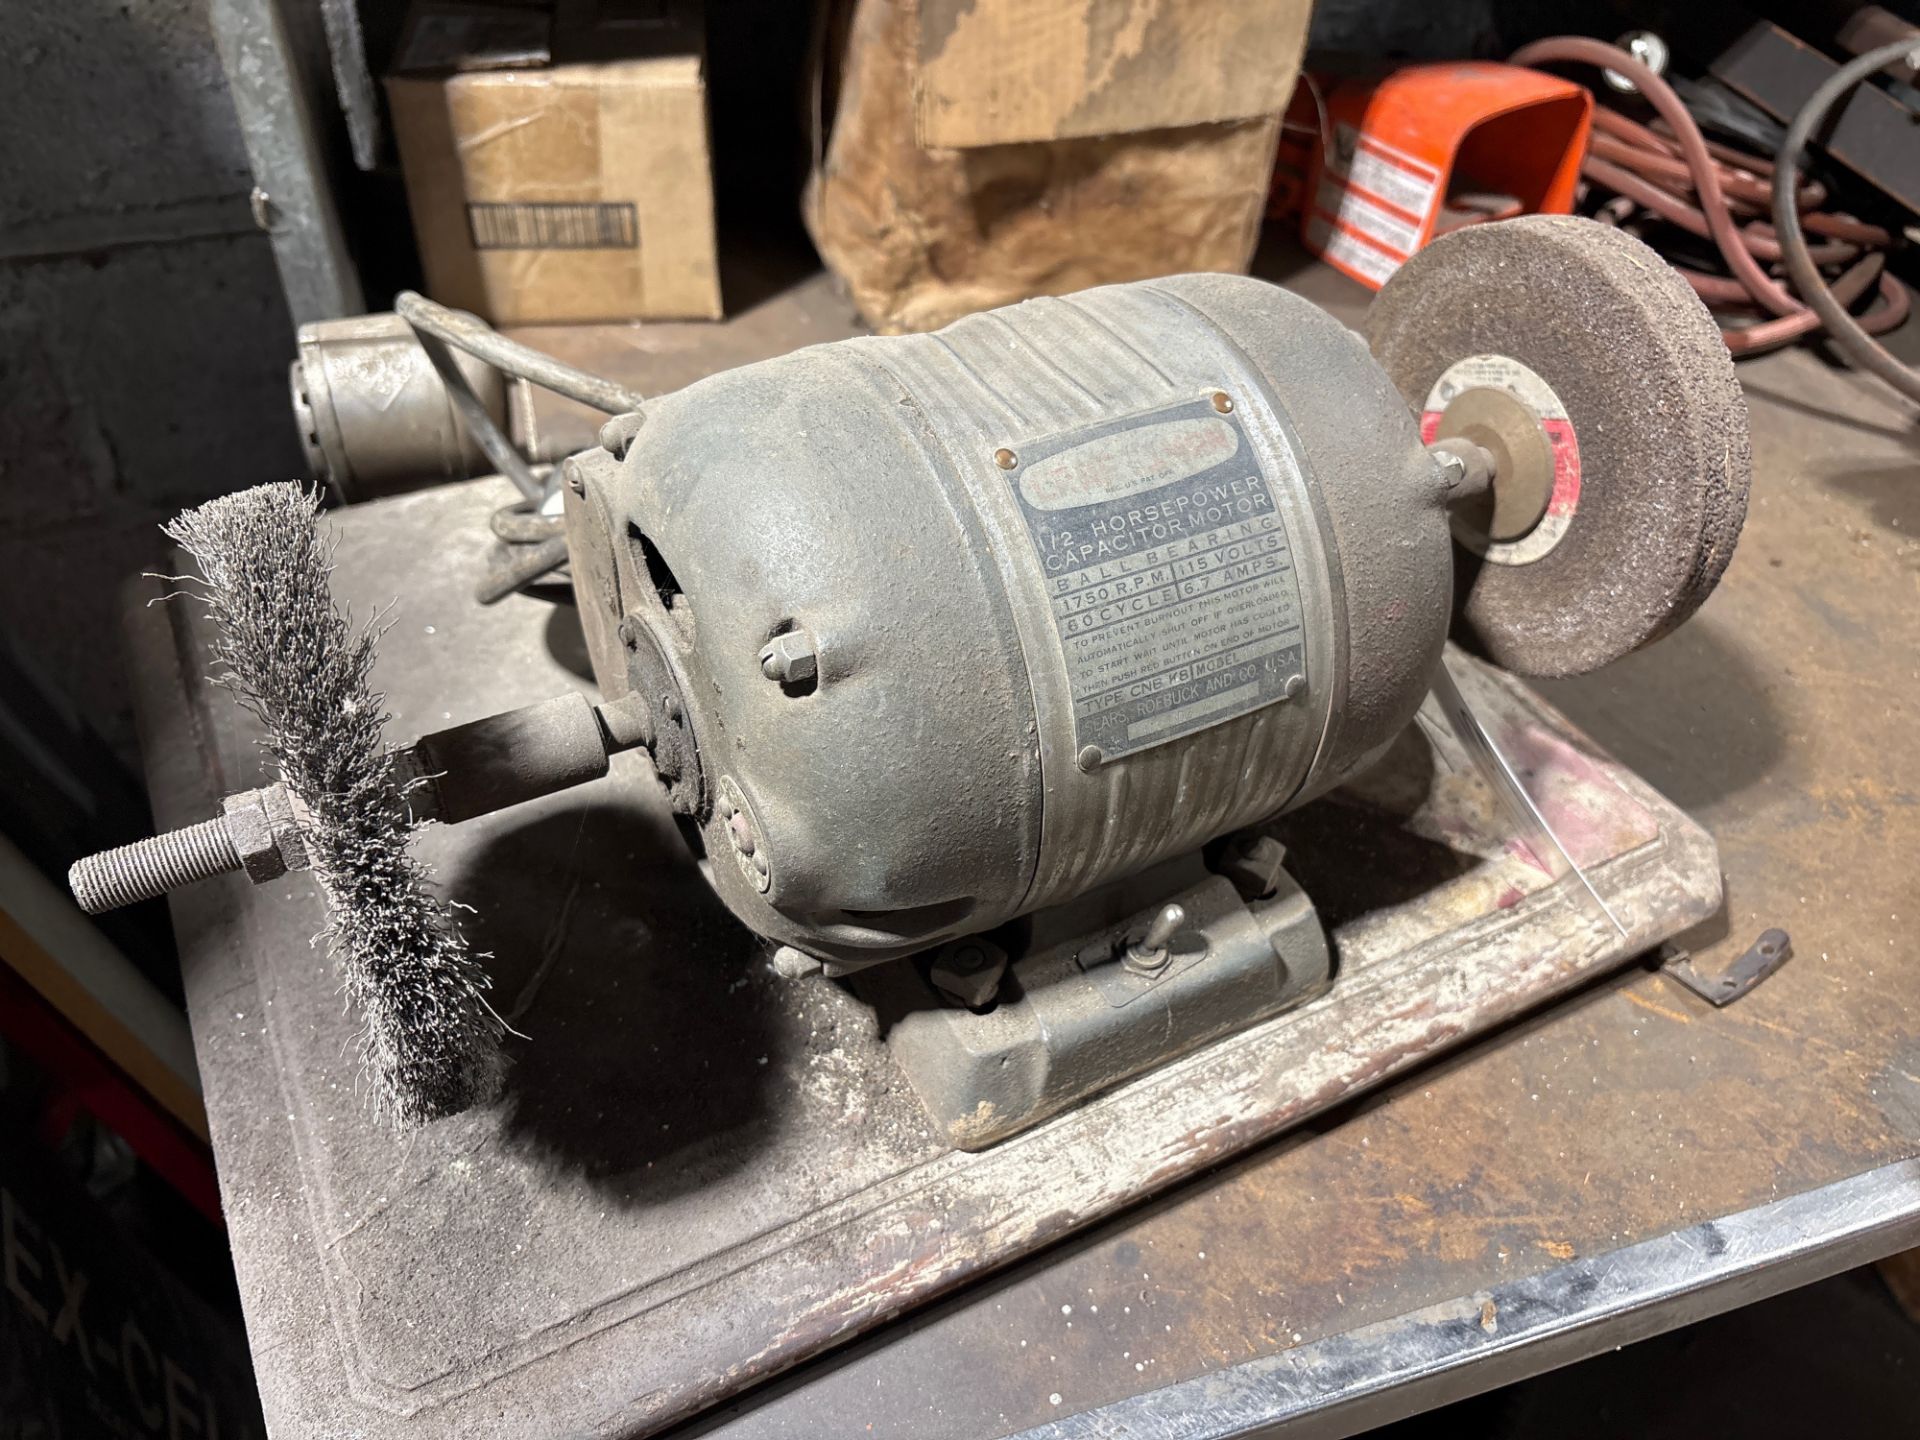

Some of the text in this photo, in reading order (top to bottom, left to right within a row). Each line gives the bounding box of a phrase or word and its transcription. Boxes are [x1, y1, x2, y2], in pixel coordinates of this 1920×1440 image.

[1038, 474, 1261, 553] 1/2 HORSEPOWER
[1044, 492, 1267, 571] CAPACITOR MOTOR
[1056, 516, 1273, 592] BALL BEARING
[1178, 534, 1278, 575] 115 VOLTS
[1062, 586, 1109, 611] 1750
[1098, 588, 1173, 622] CYCLE
[1183, 576, 1211, 595] 6.7
[1073, 638, 1089, 649] TO
[1091, 621, 1141, 643] PREVENT
[1143, 603, 1194, 626] BURNOUT
[1076, 631, 1156, 664] AUTOMATICALLY
[1161, 621, 1188, 636] SHUT
[1097, 655, 1128, 673] START
[1134, 647, 1156, 660] WAIT
[1193, 623, 1226, 641] MOTOR
[1195, 651, 1238, 675] MODEL
[1112, 668, 1136, 683] PUSH
[1139, 660, 1159, 674] RED
[1084, 690, 1123, 713] TYPE
[1136, 683, 1200, 717] ROEBUCK
[1204, 671, 1233, 693] AND
